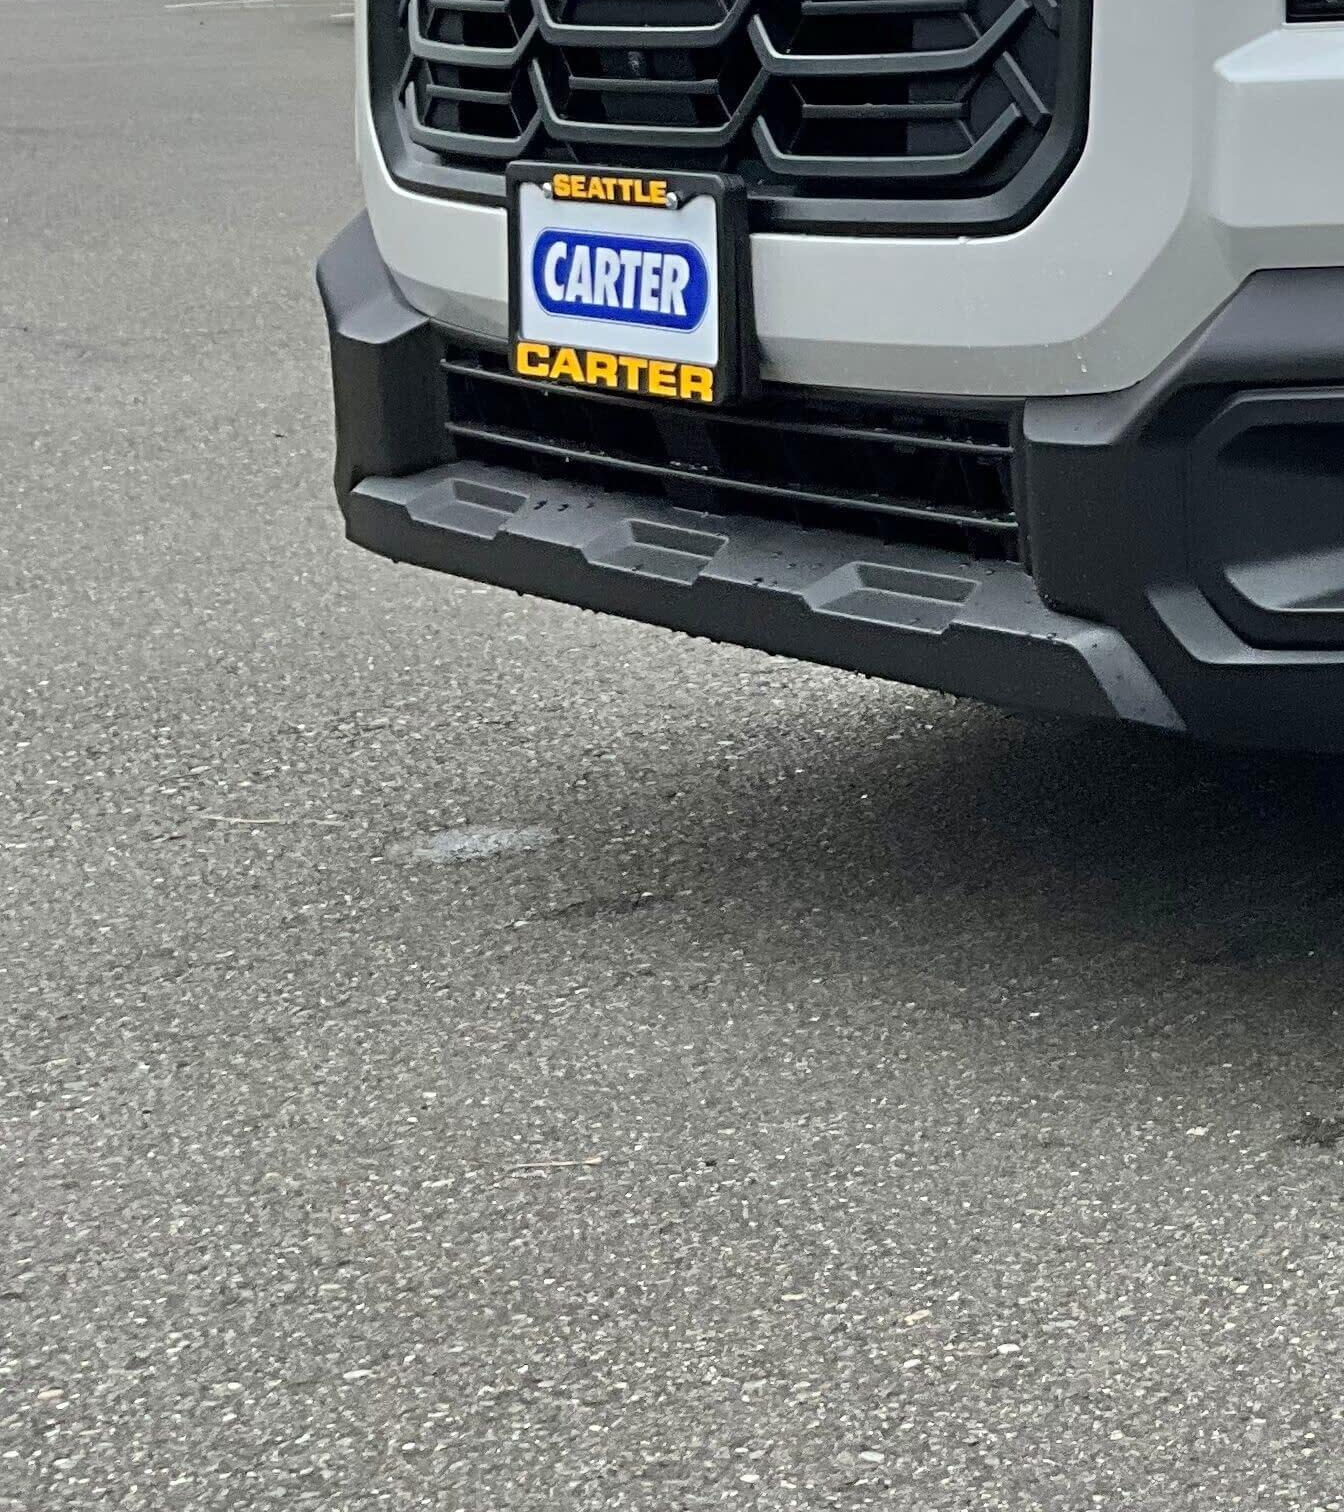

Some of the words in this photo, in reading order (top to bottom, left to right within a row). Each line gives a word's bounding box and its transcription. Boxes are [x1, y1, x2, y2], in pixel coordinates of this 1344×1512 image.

[553, 174, 667, 204] SEATTLE
[544, 241, 690, 316] CARTER
[517, 342, 714, 402] CARTER
